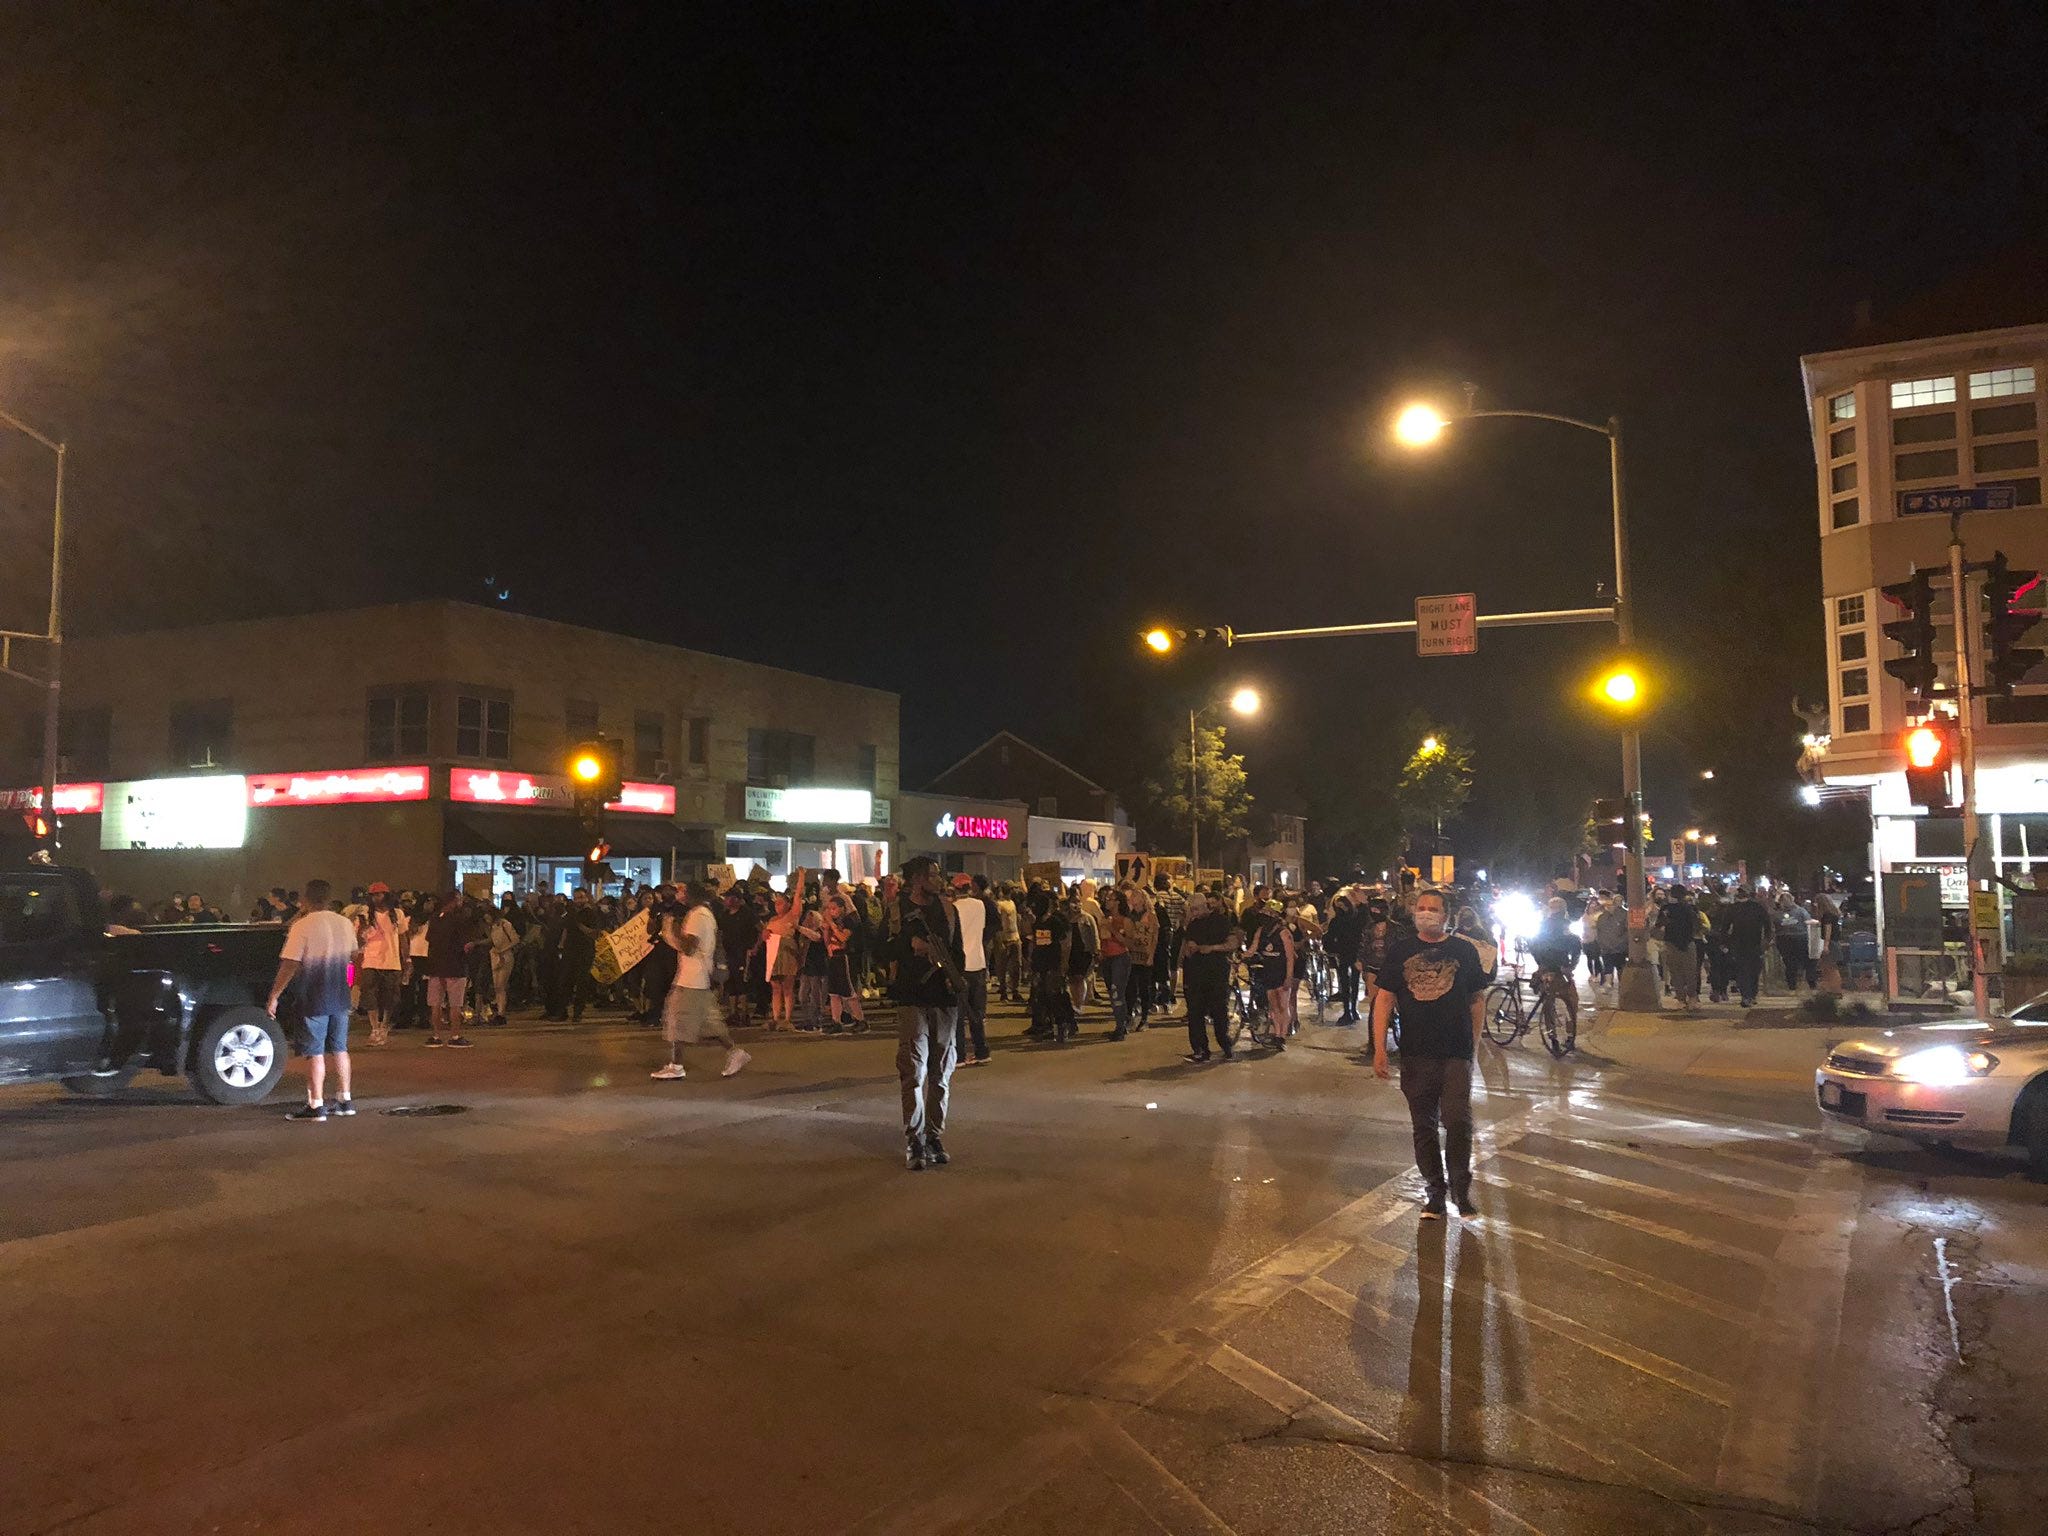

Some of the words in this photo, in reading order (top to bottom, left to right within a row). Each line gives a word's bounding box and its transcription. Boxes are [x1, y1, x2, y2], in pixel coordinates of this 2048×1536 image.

[1928, 495, 1972, 509] Swan
[1420, 604, 1445, 614] RIGHT
[1449, 602, 1471, 612] LANE
[1431, 618, 1462, 631] MUST
[1422, 637, 1445, 648] TURN
[1447, 635, 1474, 647] RIGHT
[956, 817, 1008, 839] CLEANERS
[1062, 831, 1105, 852] KUMON
